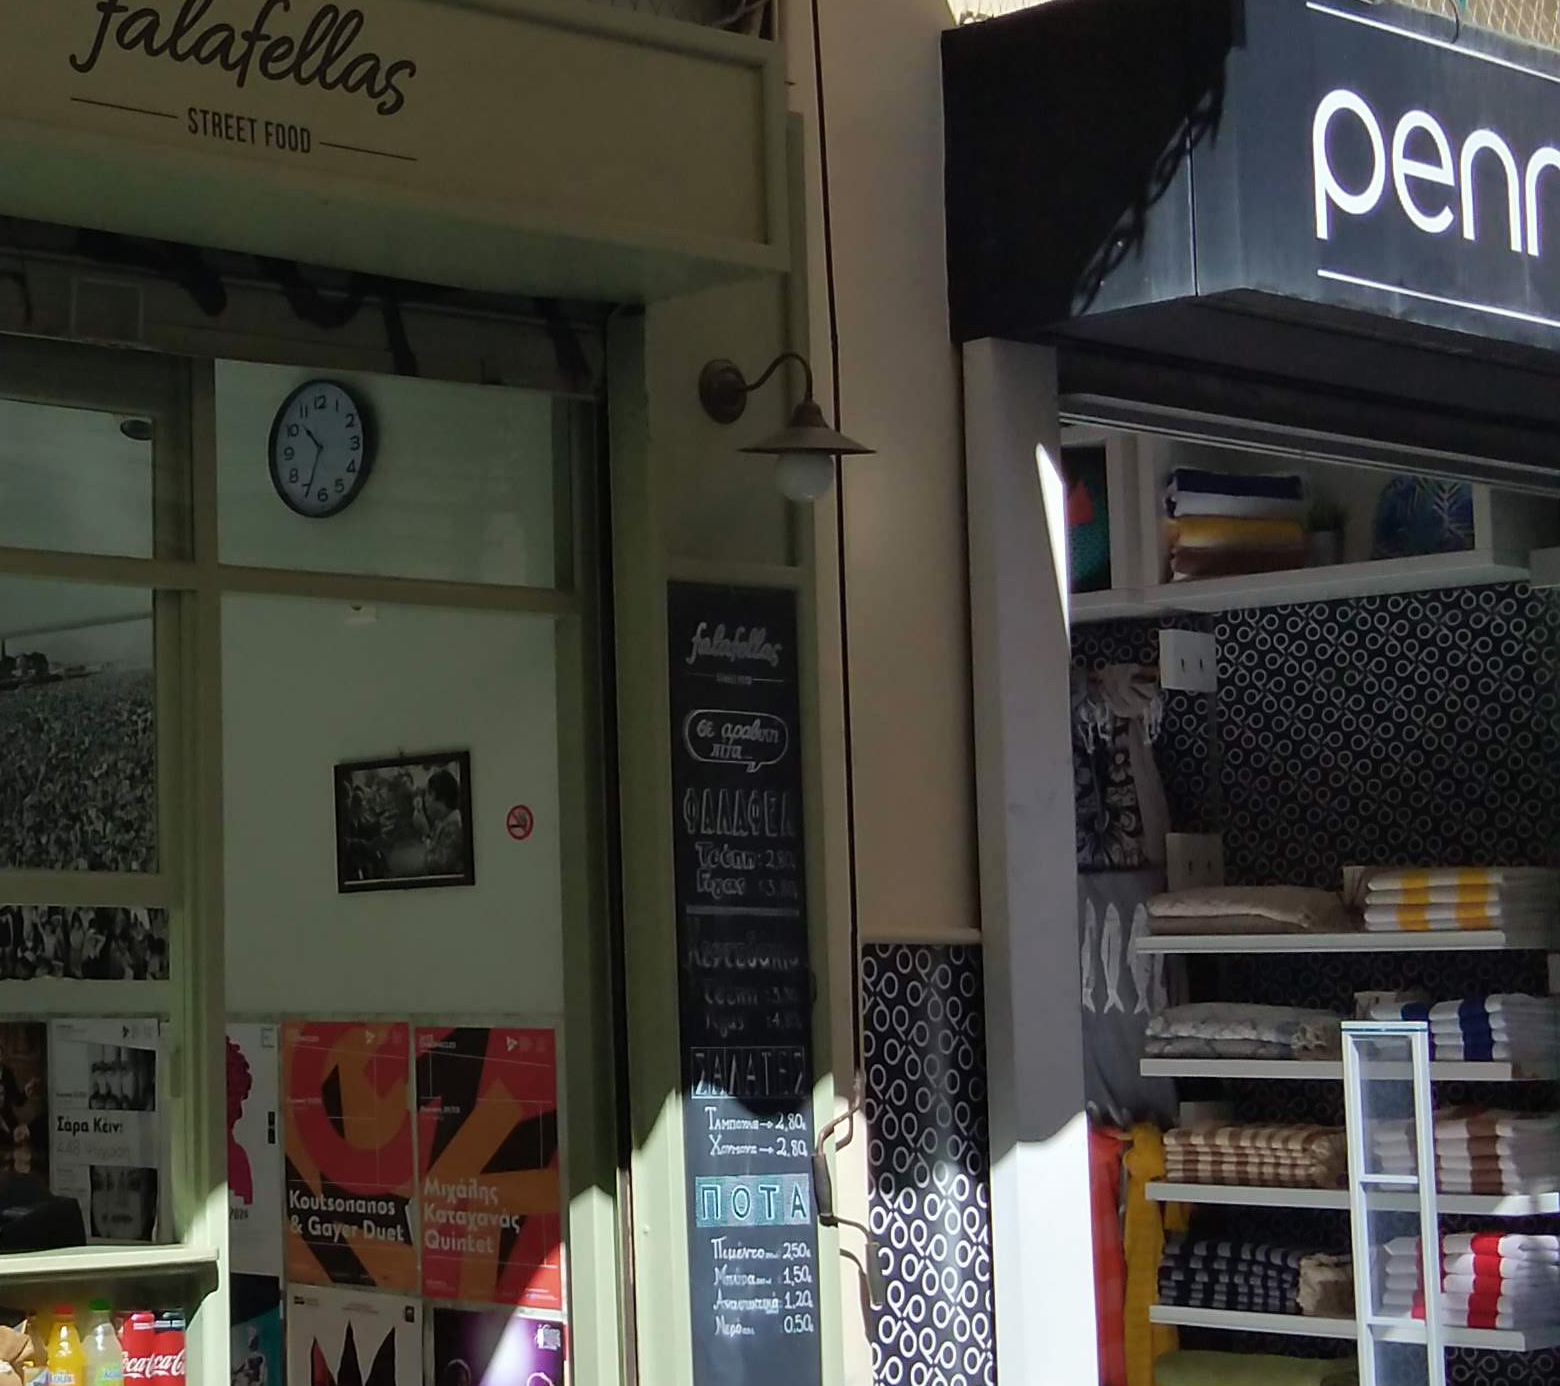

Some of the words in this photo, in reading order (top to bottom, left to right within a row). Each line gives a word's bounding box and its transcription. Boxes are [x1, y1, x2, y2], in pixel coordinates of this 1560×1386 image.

[188, 107, 257, 145] STREET
[265, 122, 311, 154] FOOD
[313, 395, 327, 410] 12
[345, 414, 355, 428] 2
[287, 423, 299, 437] 10
[350, 436, 360, 451] 3
[284, 447, 294, 461] 9
[346, 459, 356, 473] 4
[290, 469, 298, 483] 8
[301, 483, 311, 498] 7
[334, 479, 345, 493] 5
[317, 488, 328, 502] 6
[701, 1184, 806, 1221] ΠΟΤΑ
[363, 1219, 405, 1242] Duet
[424, 1229, 494, 1253] Quintet
